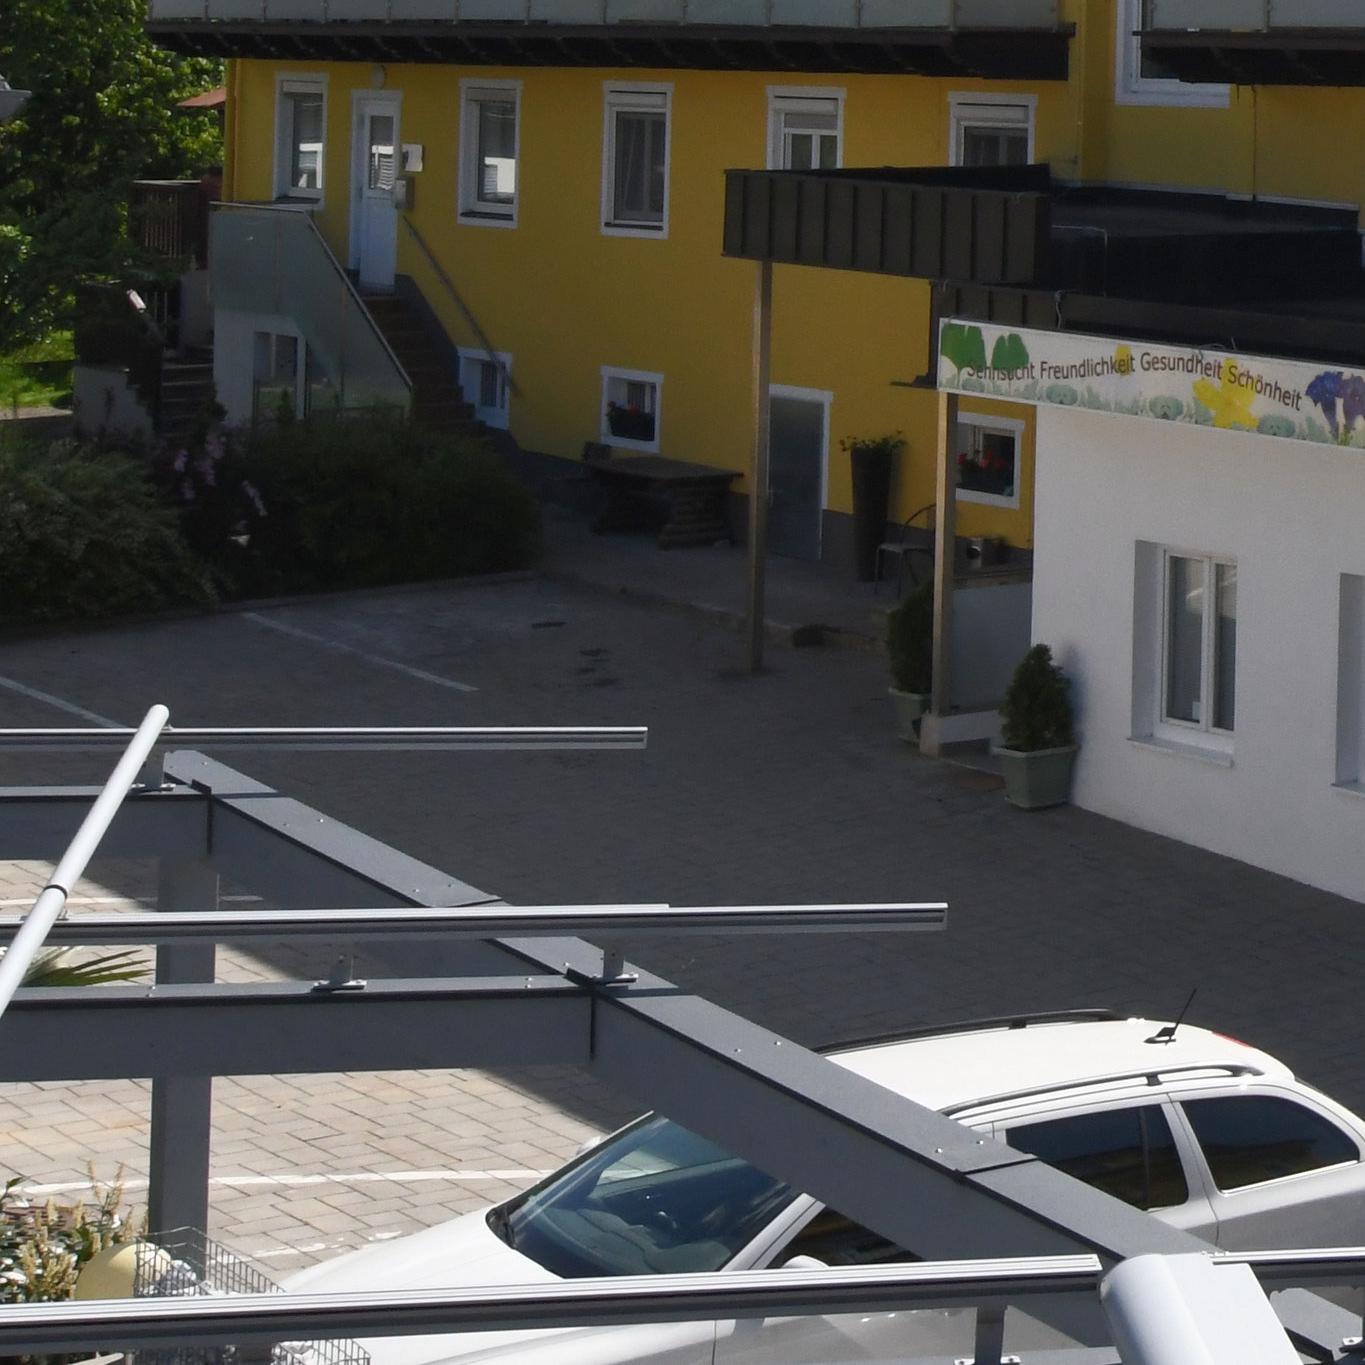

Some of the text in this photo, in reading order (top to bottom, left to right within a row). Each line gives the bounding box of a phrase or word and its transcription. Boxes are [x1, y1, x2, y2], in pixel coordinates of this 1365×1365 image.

[1040, 354, 1135, 380] Freundlichkeit
[1140, 352, 1223, 380] Gesundheit
[1228, 365, 1302, 411] Schönheit
